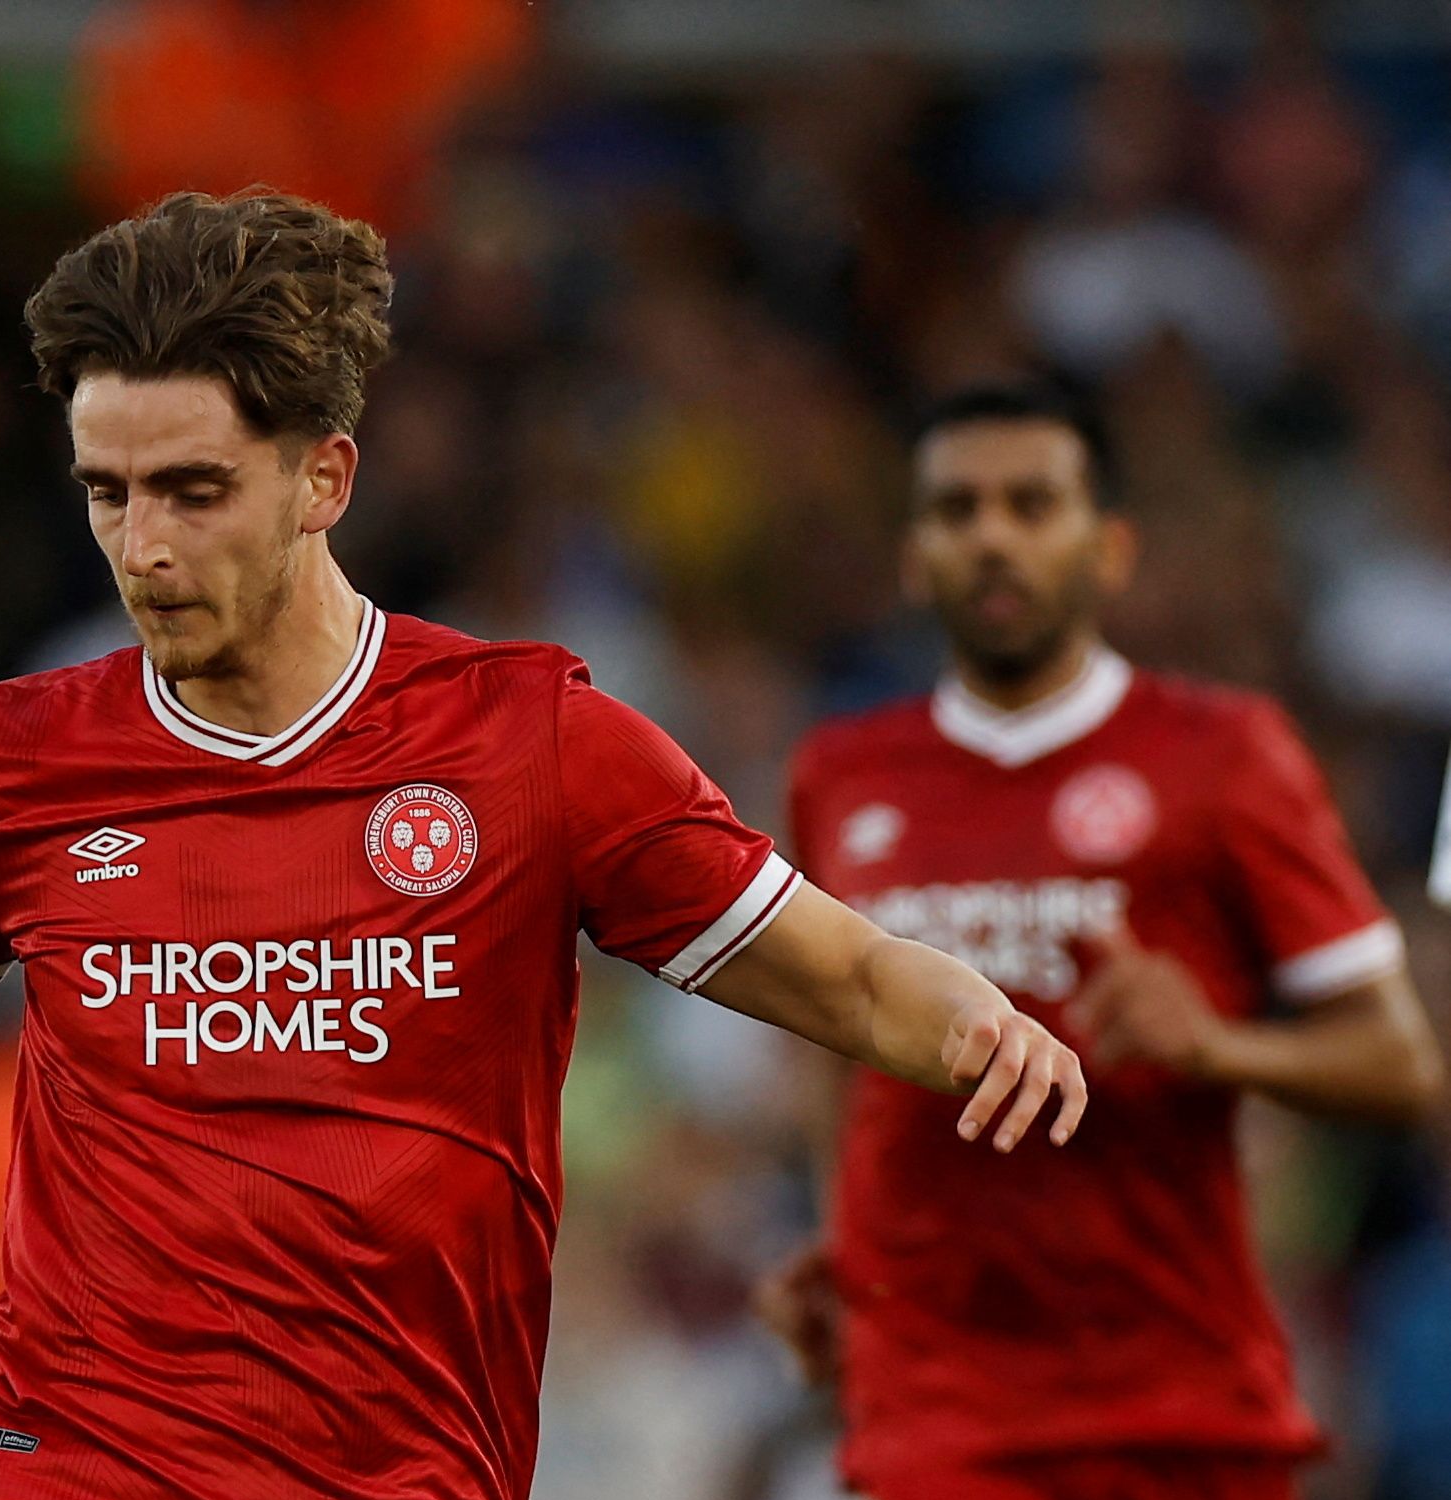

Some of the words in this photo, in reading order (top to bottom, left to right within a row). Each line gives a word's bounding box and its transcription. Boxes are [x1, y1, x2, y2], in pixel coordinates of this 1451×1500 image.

[369, 795, 400, 857] SHREWSBURY
[400, 788, 429, 800] TOWN
[431, 790, 468, 828] FOOTBALL
[462, 828, 473, 854] CLUB
[408, 808, 431, 818] 1886
[76, 863, 139, 884] umbro
[385, 871, 423, 892] FLOREAT
[426, 869, 462, 892] SALOPIA
[80, 934, 460, 1009] SHROPSHIRE
[144, 997, 389, 1066] HOMES
